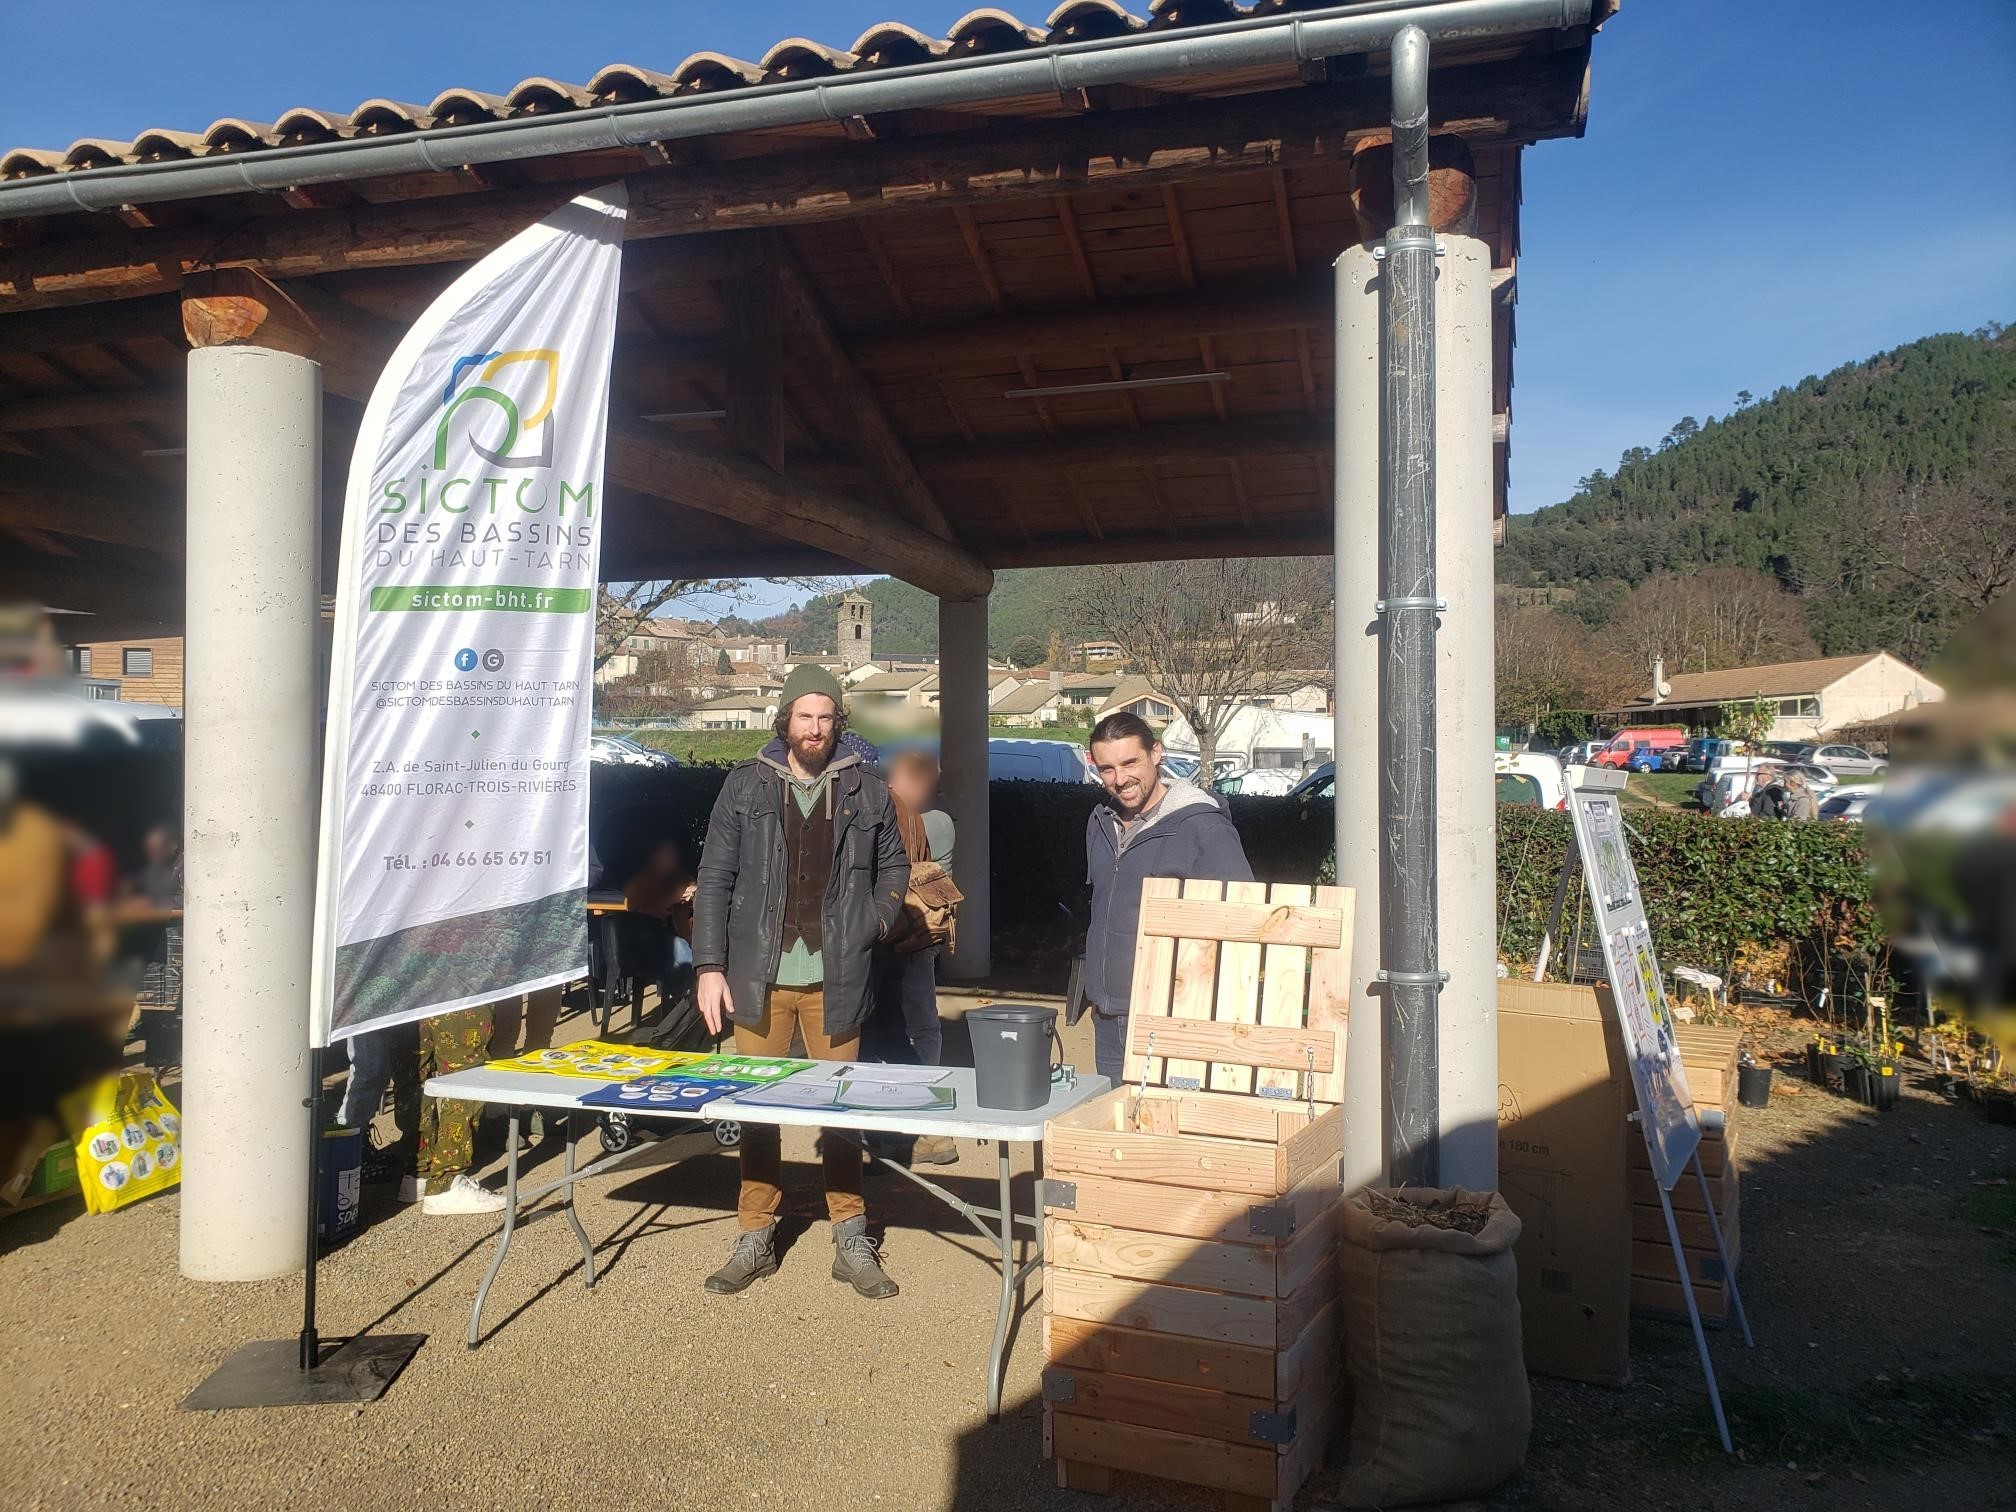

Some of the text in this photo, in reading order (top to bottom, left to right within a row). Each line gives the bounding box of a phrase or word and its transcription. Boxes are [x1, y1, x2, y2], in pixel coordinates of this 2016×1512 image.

[378, 522, 592, 547] DES BASSINS
[376, 549, 591, 570] DU HAUT-TARN
[411, 590, 554, 609] sictom-bht.fr
[371, 680, 580, 692] SICTOM DES BASSINS DU HAUT TARN
[372, 759, 569, 773] Z.A. de Saint-Julien du Gourg
[361, 783, 402, 797] 48400
[383, 854, 417, 871] Tél.
[431, 852, 450, 867] 04
[455, 851, 477, 866] 66
[482, 851, 503, 866] 65
[508, 851, 529, 866] 67
[533, 850, 552, 865] 51
[1509, 1139, 1529, 1153] 180
[1532, 1144, 1550, 1155] cm
